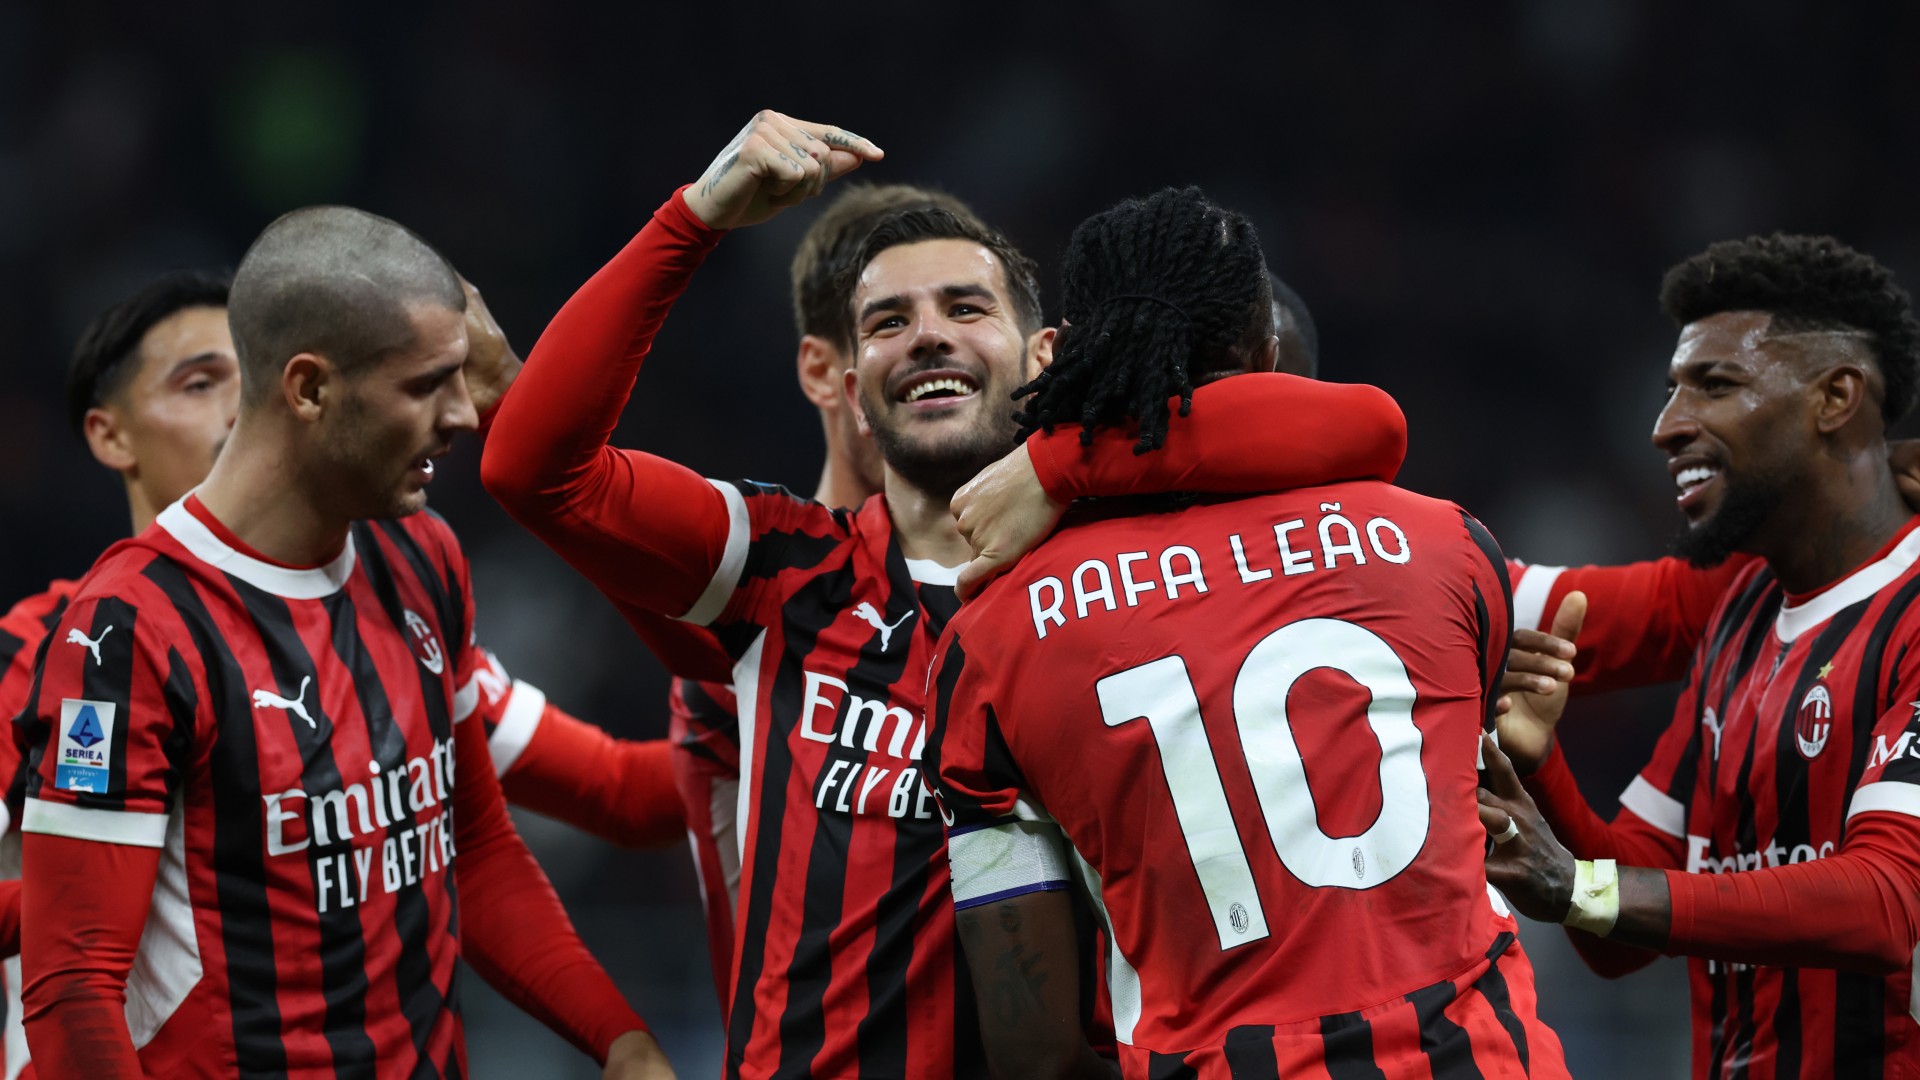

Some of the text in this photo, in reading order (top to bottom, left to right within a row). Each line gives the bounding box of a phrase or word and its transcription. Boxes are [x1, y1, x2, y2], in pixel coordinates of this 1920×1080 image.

[1028, 502, 1412, 640] RAFA LEÃO
[66, 748, 103, 761] SERIE A
[815, 759, 890, 815] FLY
[1096, 617, 1431, 951] 10
[316, 847, 373, 913] FLY
